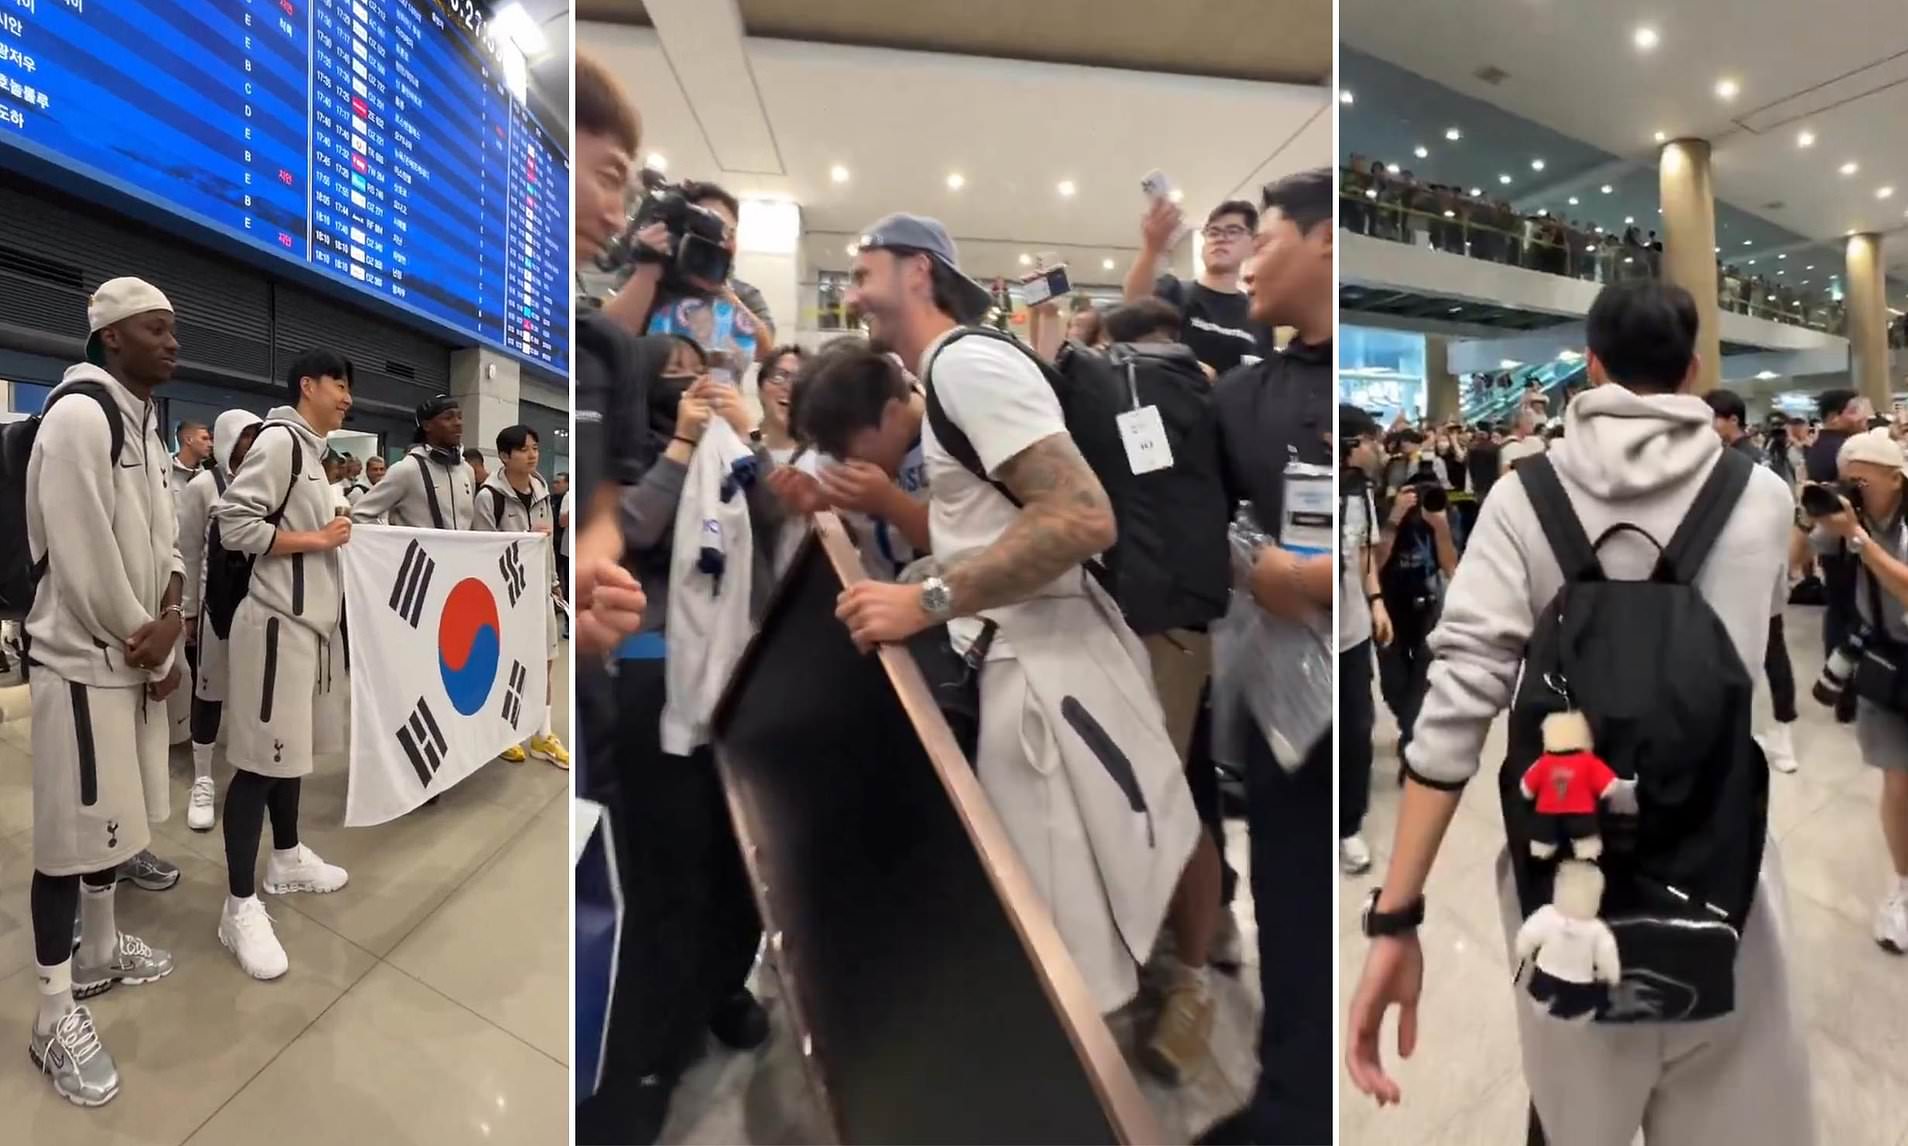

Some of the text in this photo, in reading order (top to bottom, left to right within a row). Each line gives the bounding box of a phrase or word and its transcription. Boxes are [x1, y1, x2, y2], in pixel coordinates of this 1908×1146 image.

[245, 13, 251, 26] E
[245, 36, 251, 49] E
[244, 59, 251, 72] B
[244, 83, 251, 95] C
[244, 105, 251, 117] D
[244, 128, 251, 139] E
[244, 151, 251, 162] B
[244, 173, 251, 185] E
[244, 195, 251, 207] B
[244, 217, 251, 229] E
